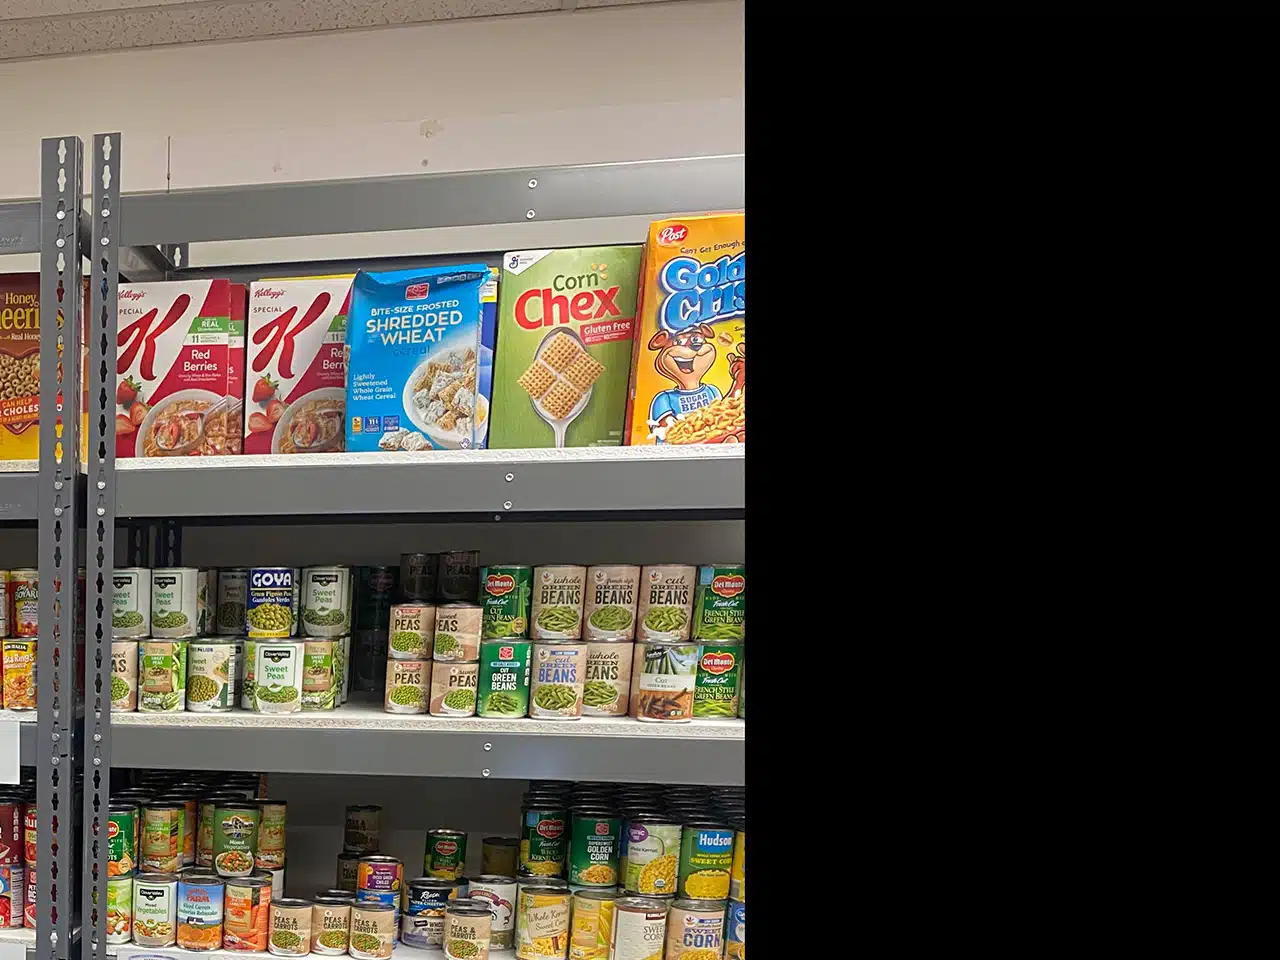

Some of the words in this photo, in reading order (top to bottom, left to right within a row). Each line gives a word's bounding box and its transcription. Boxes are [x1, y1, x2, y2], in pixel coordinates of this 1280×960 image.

[661, 227, 686, 243] Post
[553, 272, 599, 292] Corn
[254, 287, 286, 301] Kellogg's
[5, 292, 37, 307] Honey
[253, 306, 283, 314] SPECIAL
[371, 305, 414, 317] BITE-SIZE
[416, 299, 460, 313] FROSTED
[515, 286, 622, 330] Chex
[201, 321, 219, 329] REAL
[366, 310, 463, 334] SHREDDED
[584, 324, 612, 335] Gluten
[613, 321, 631, 331] Free
[117, 293, 191, 381] K
[252, 292, 332, 381] K
[380, 326, 447, 346] WHEAT
[191, 349, 211, 362] Red
[183, 360, 218, 372] Berries
[353, 373, 376, 382] Lightly
[353, 379, 388, 388] Sweetened
[353, 386, 373, 394] Whole
[375, 386, 393, 394] Grain
[353, 393, 373, 401] Wheat
[375, 392, 396, 400] Cereal
[679, 392, 708, 405] SUGAR
[2, 400, 13, 409] CAN
[14, 398, 32, 407] HELP
[681, 399, 710, 413] BEAR
[252, 572, 292, 587] GOYA
[553, 576, 581, 584] whole
[665, 577, 685, 585] cut
[313, 589, 336, 597] Sweet
[541, 590, 581, 605] BEANS
[595, 590, 632, 605] BEANS
[649, 590, 688, 605] BEANS
[155, 598, 171, 606] Peas
[315, 596, 333, 604] Peas
[704, 609, 729, 618] FRENCH
[394, 619, 421, 631] PEAS
[589, 652, 619, 660] whole
[264, 665, 288, 674] Sweet
[267, 672, 285, 680] Peas
[394, 673, 420, 685] PEAS
[491, 673, 517, 682] GREEN
[539, 668, 576, 683] BEANS
[655, 676, 668, 684] Cut
[449, 675, 476, 687] PEAS
[491, 681, 517, 691] BEANS
[699, 834, 732, 846] Hudson
[274, 916, 291, 924] PEAS
[324, 916, 342, 924] PEAS
[354, 918, 372, 926] PEAS
[373, 919, 378, 927] &
[273, 923, 298, 931] CARROTS
[354, 925, 378, 934] CARROTS
[450, 924, 468, 933] PEAS
[535, 922, 557, 931] Sweet
[450, 932, 476, 940] CARROTS
[683, 934, 720, 948] CORN
